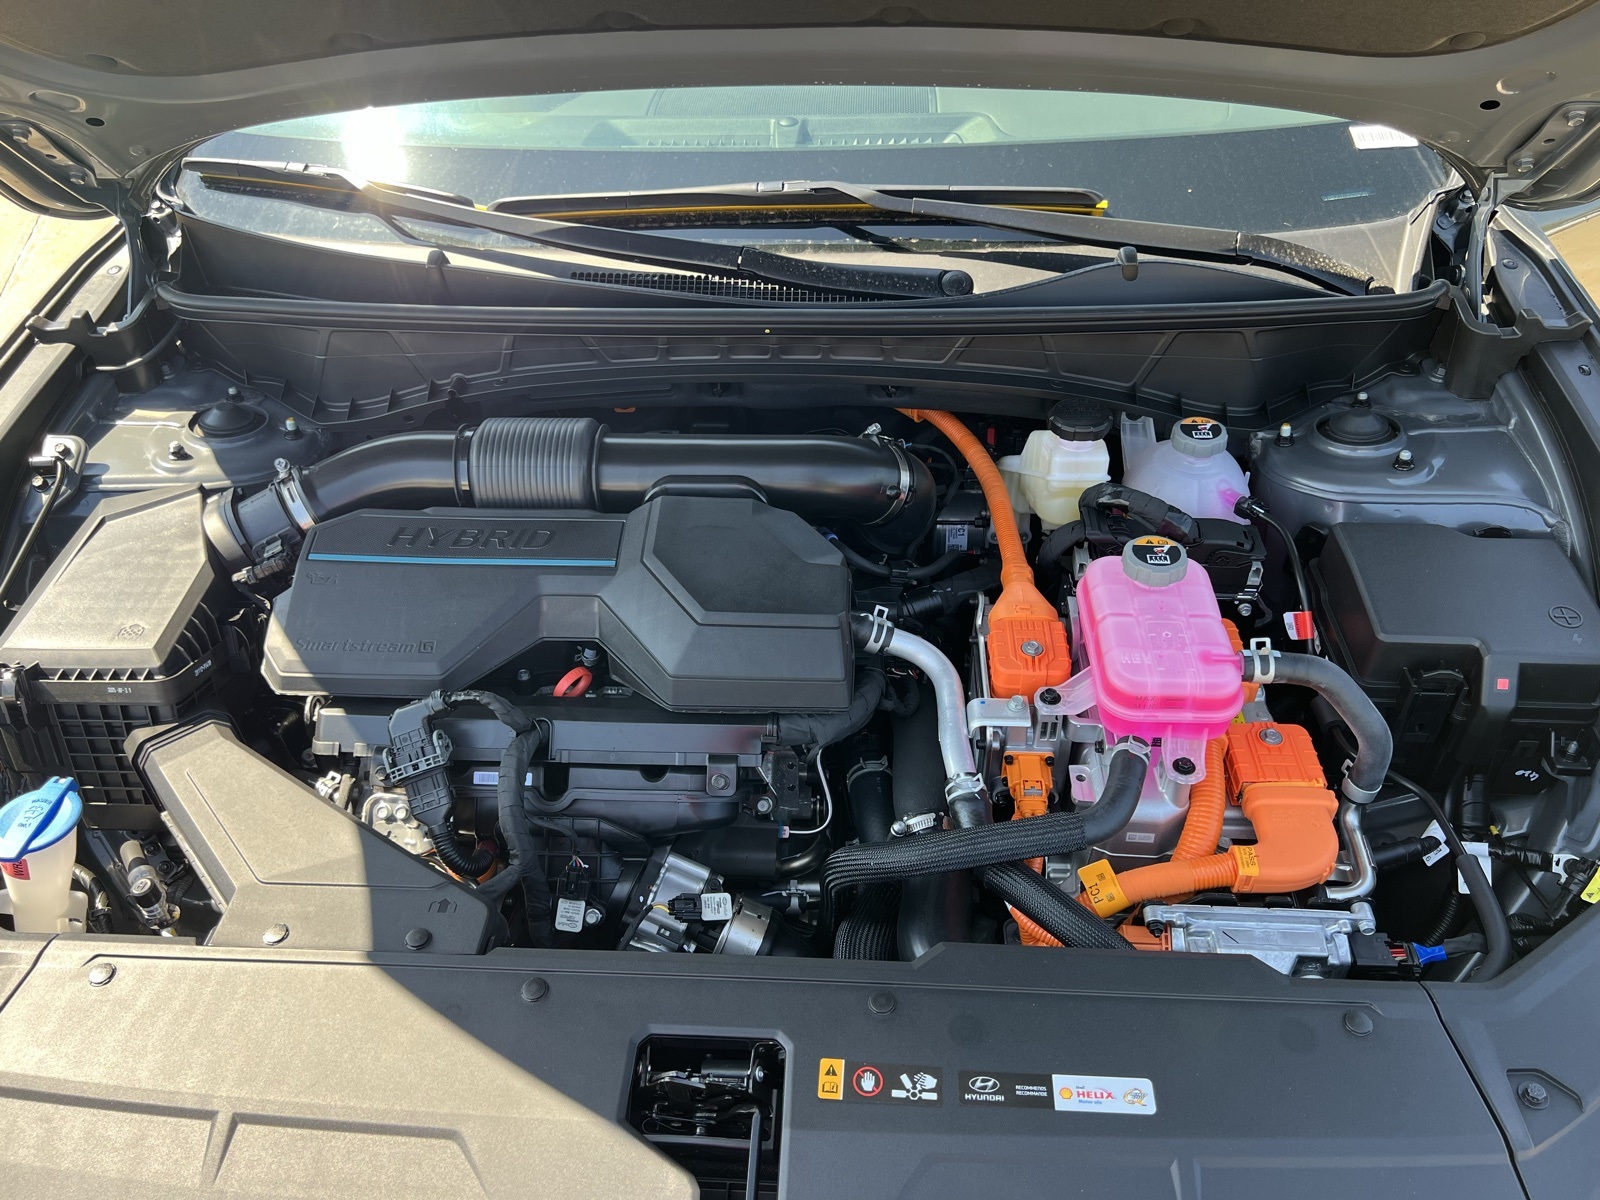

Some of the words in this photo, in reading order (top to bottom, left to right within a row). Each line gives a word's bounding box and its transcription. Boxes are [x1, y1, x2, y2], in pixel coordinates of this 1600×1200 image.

[387, 526, 557, 550] HYBRID
[295, 639, 416, 653] Smartstream
[1246, 846, 1256, 866] PASS
[1088, 882, 1104, 904] PC1
[964, 1093, 1005, 1102] HYUNDAI
[1076, 1090, 1115, 1099] HELIX
